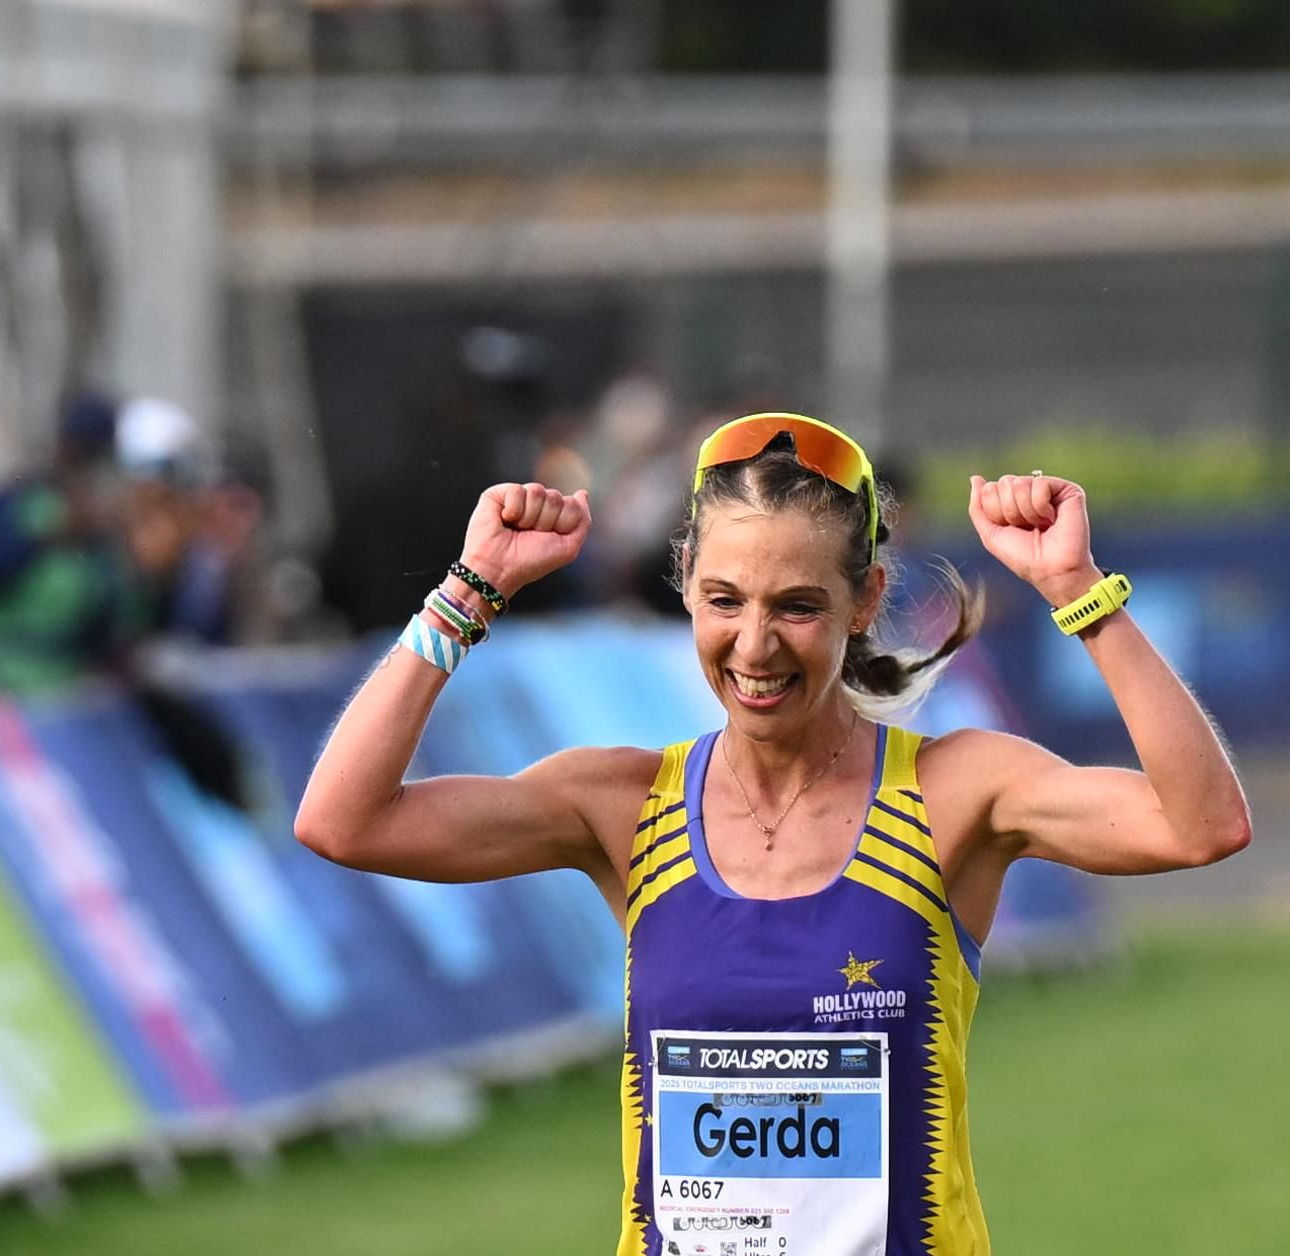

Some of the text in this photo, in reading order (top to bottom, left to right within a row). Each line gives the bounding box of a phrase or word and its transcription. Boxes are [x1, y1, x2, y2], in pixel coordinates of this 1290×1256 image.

[813, 990, 906, 1013] HOLLYWOOD
[814, 1008, 905, 1023] ATHLETICS CLUB
[700, 1048, 829, 1070] TOTALSPORTS
[682, 1080, 747, 1090] TOTALSPORTS
[749, 1081, 773, 1091] TWO
[776, 1081, 819, 1091] OCEANS
[821, 1081, 880, 1091] MARATHON
[693, 1101, 840, 1159] Gerda
[660, 1179, 725, 1199] A 6067
[745, 1237, 787, 1248] Half 0
